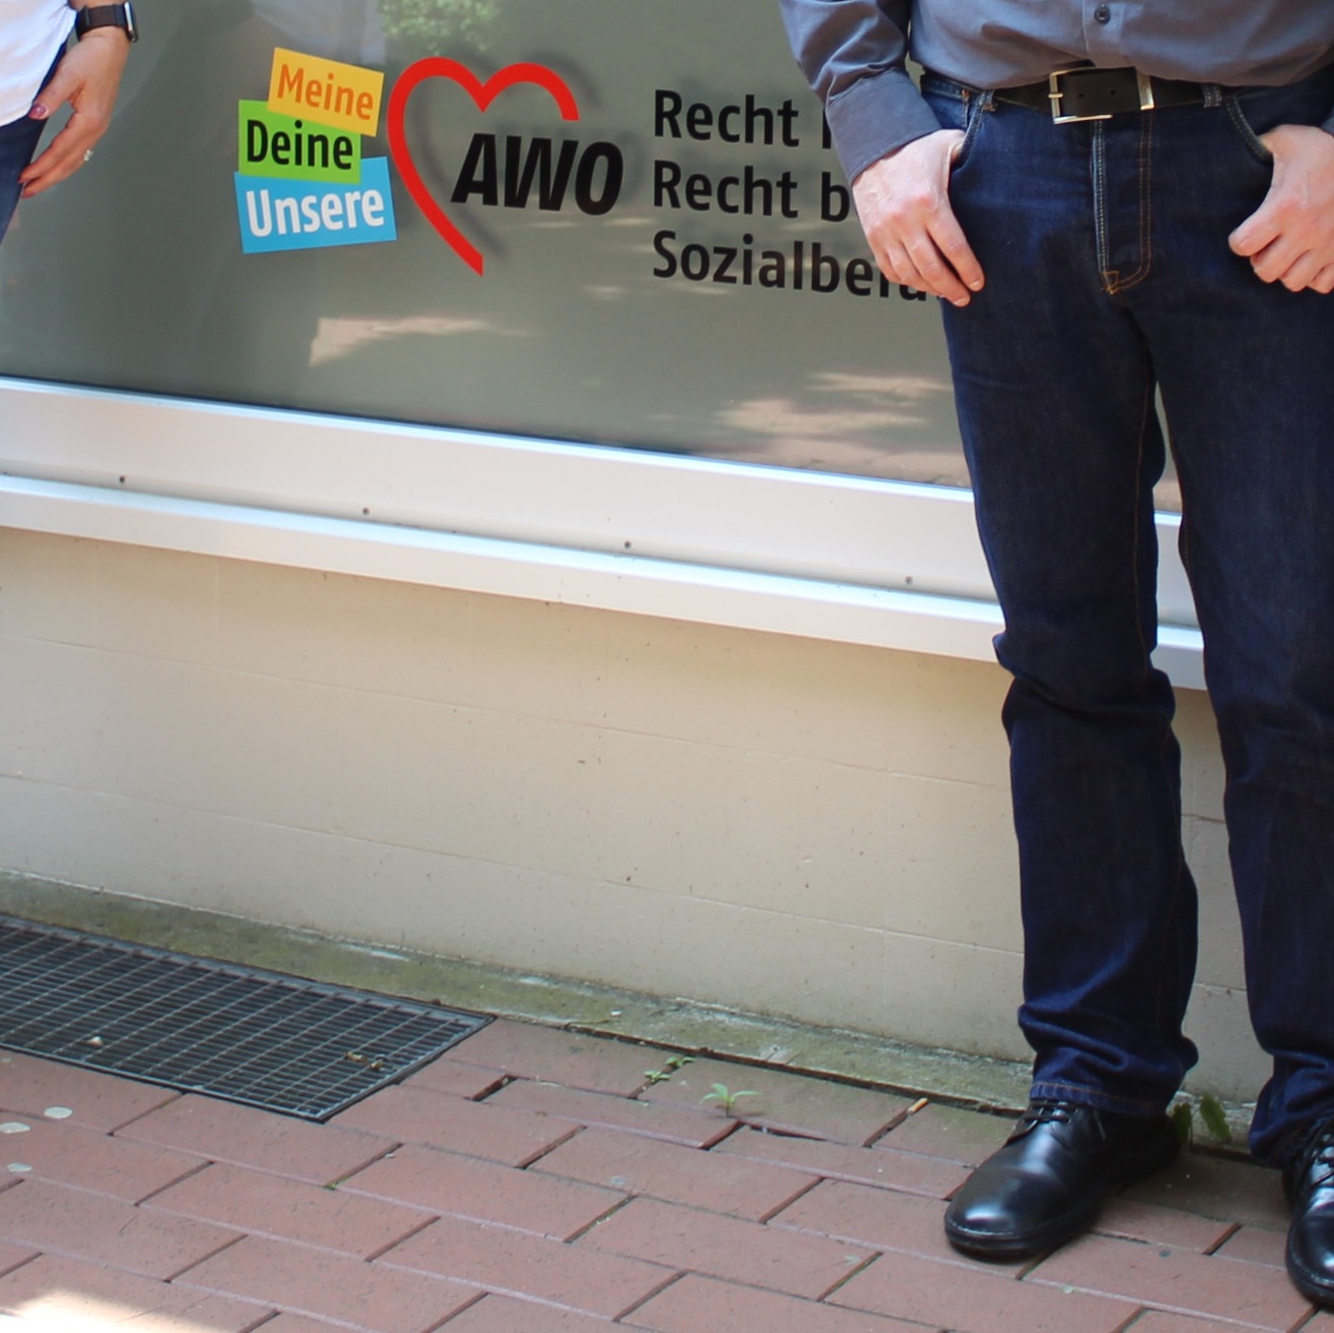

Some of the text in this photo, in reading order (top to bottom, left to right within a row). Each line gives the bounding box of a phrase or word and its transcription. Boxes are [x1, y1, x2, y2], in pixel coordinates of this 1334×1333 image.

[276, 63, 374, 121] Meine
[654, 89, 800, 148] Recht
[246, 119, 354, 171] Deine
[449, 132, 624, 216] AWO
[245, 188, 385, 238] Unsere
[653, 159, 851, 223] Recht b
[653, 229, 927, 302] Sozialbe
